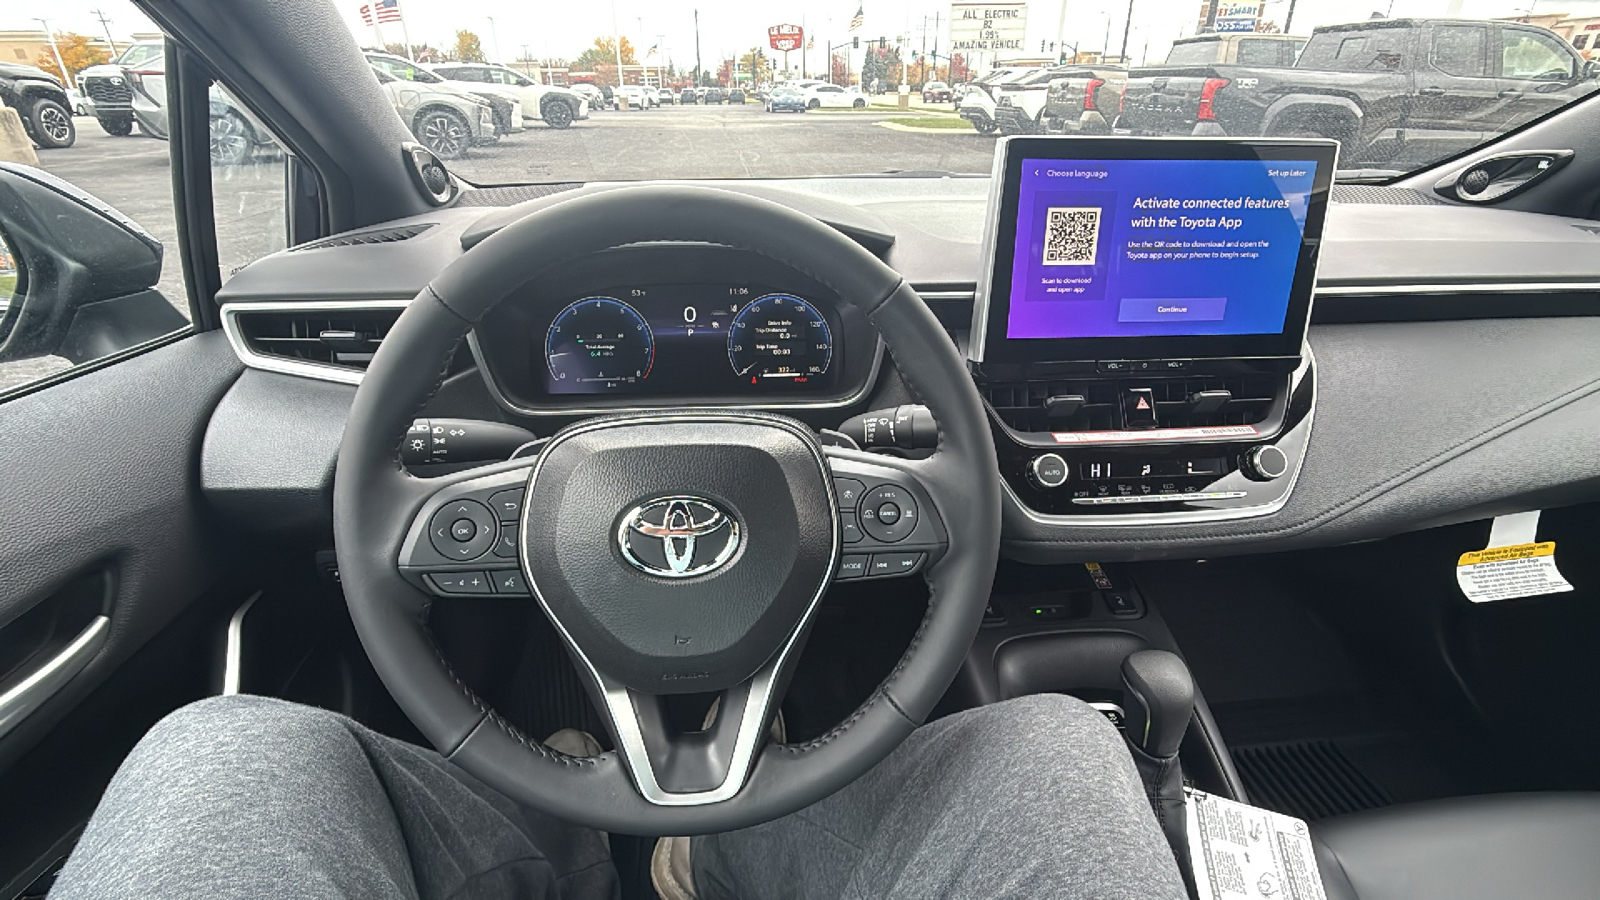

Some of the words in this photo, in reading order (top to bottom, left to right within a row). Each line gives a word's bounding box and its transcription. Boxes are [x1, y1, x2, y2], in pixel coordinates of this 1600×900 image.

[963, 10, 977, 19] ALL
[984, 10, 1018, 18] ELECTRIC
[1216, 6, 1257, 17] ETSMART
[983, 20, 992, 28] BZ
[953, 41, 988, 50] AMAZING
[991, 40, 1020, 49] VEHICLE
[1047, 170, 1074, 178] Choose
[1074, 170, 1108, 178] language
[1133, 197, 1180, 208] Activate
[1182, 197, 1242, 208] connected
[1244, 197, 1290, 208] features
[1131, 216, 1156, 228] with
[1158, 216, 1177, 228] the
[1180, 216, 1216, 230] Toyota
[1218, 216, 1242, 230] App
[684, 306, 696, 322] 0
[688, 328, 694, 336] P
[1091, 463, 1111, 478] HI
